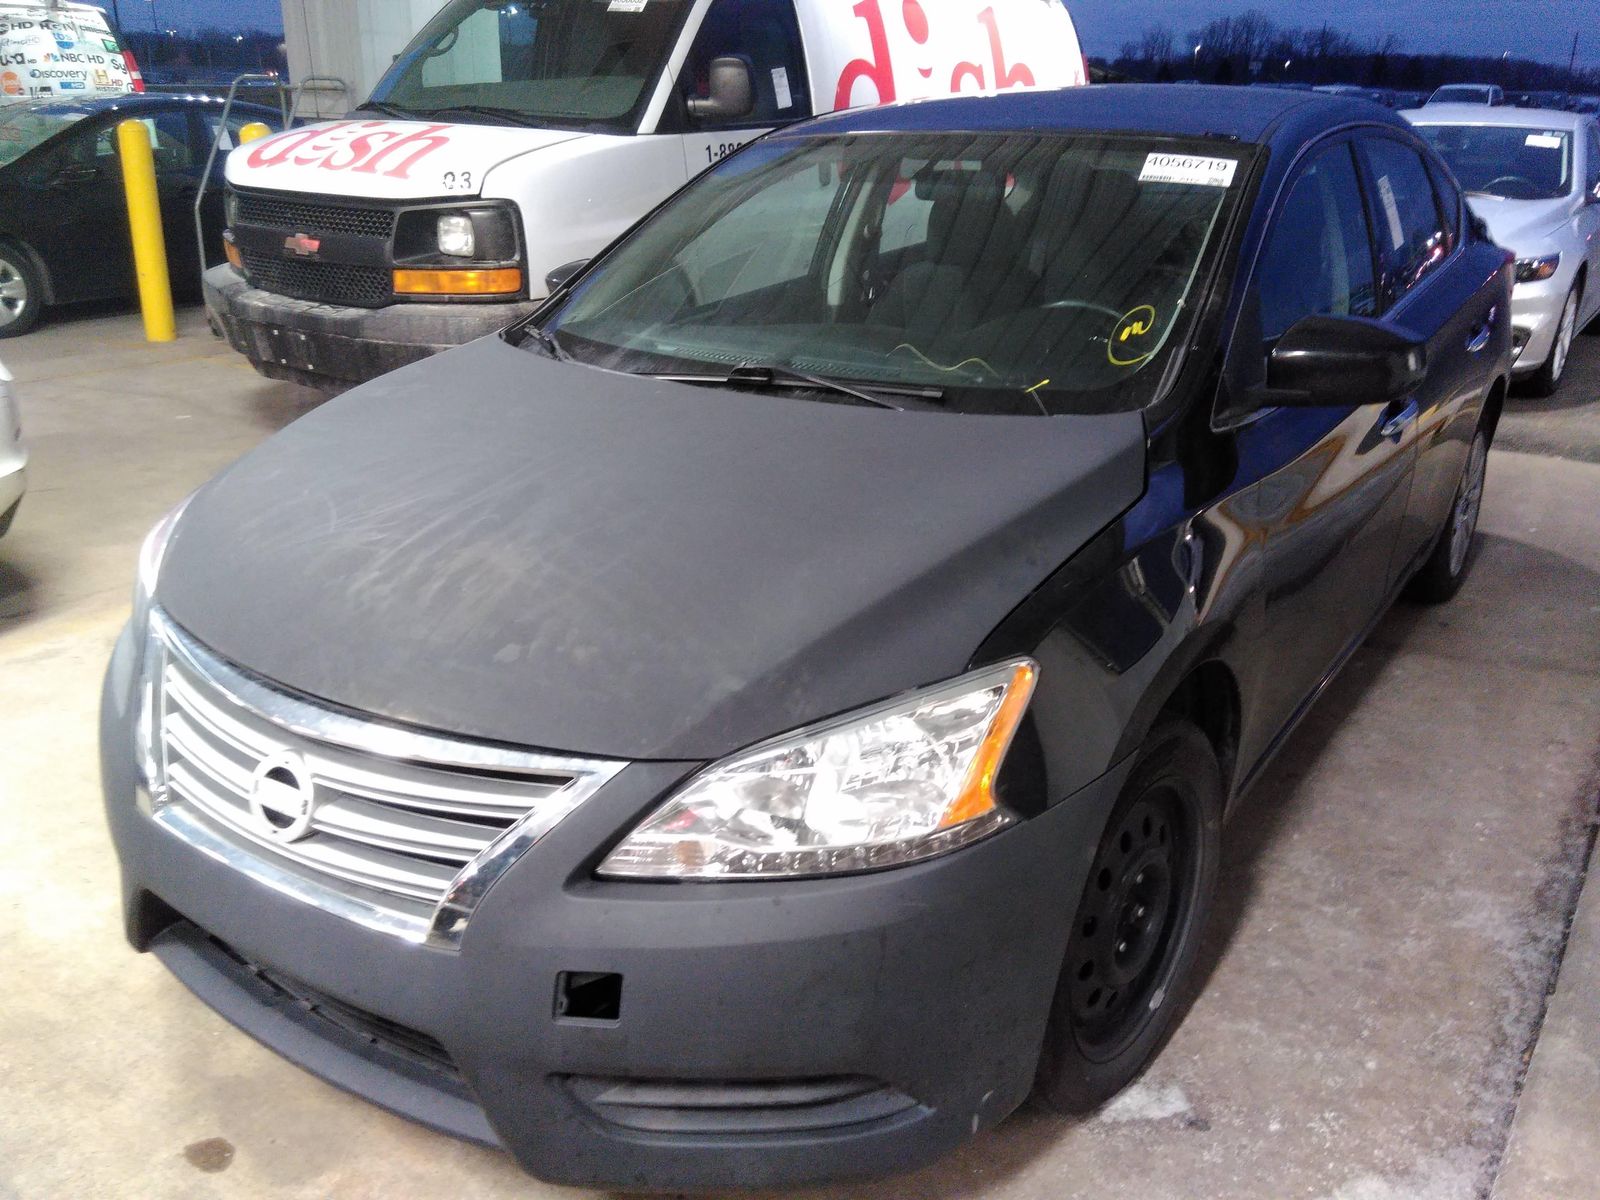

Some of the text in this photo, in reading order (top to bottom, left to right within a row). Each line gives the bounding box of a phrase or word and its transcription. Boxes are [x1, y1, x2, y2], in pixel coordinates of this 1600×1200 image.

[11, 21, 34, 30] HD
[60, 53, 105, 64] NBC HD
[29, 69, 87, 80] Discovery
[247, 121, 453, 179] dish
[1147, 156, 1228, 172] 4056719
